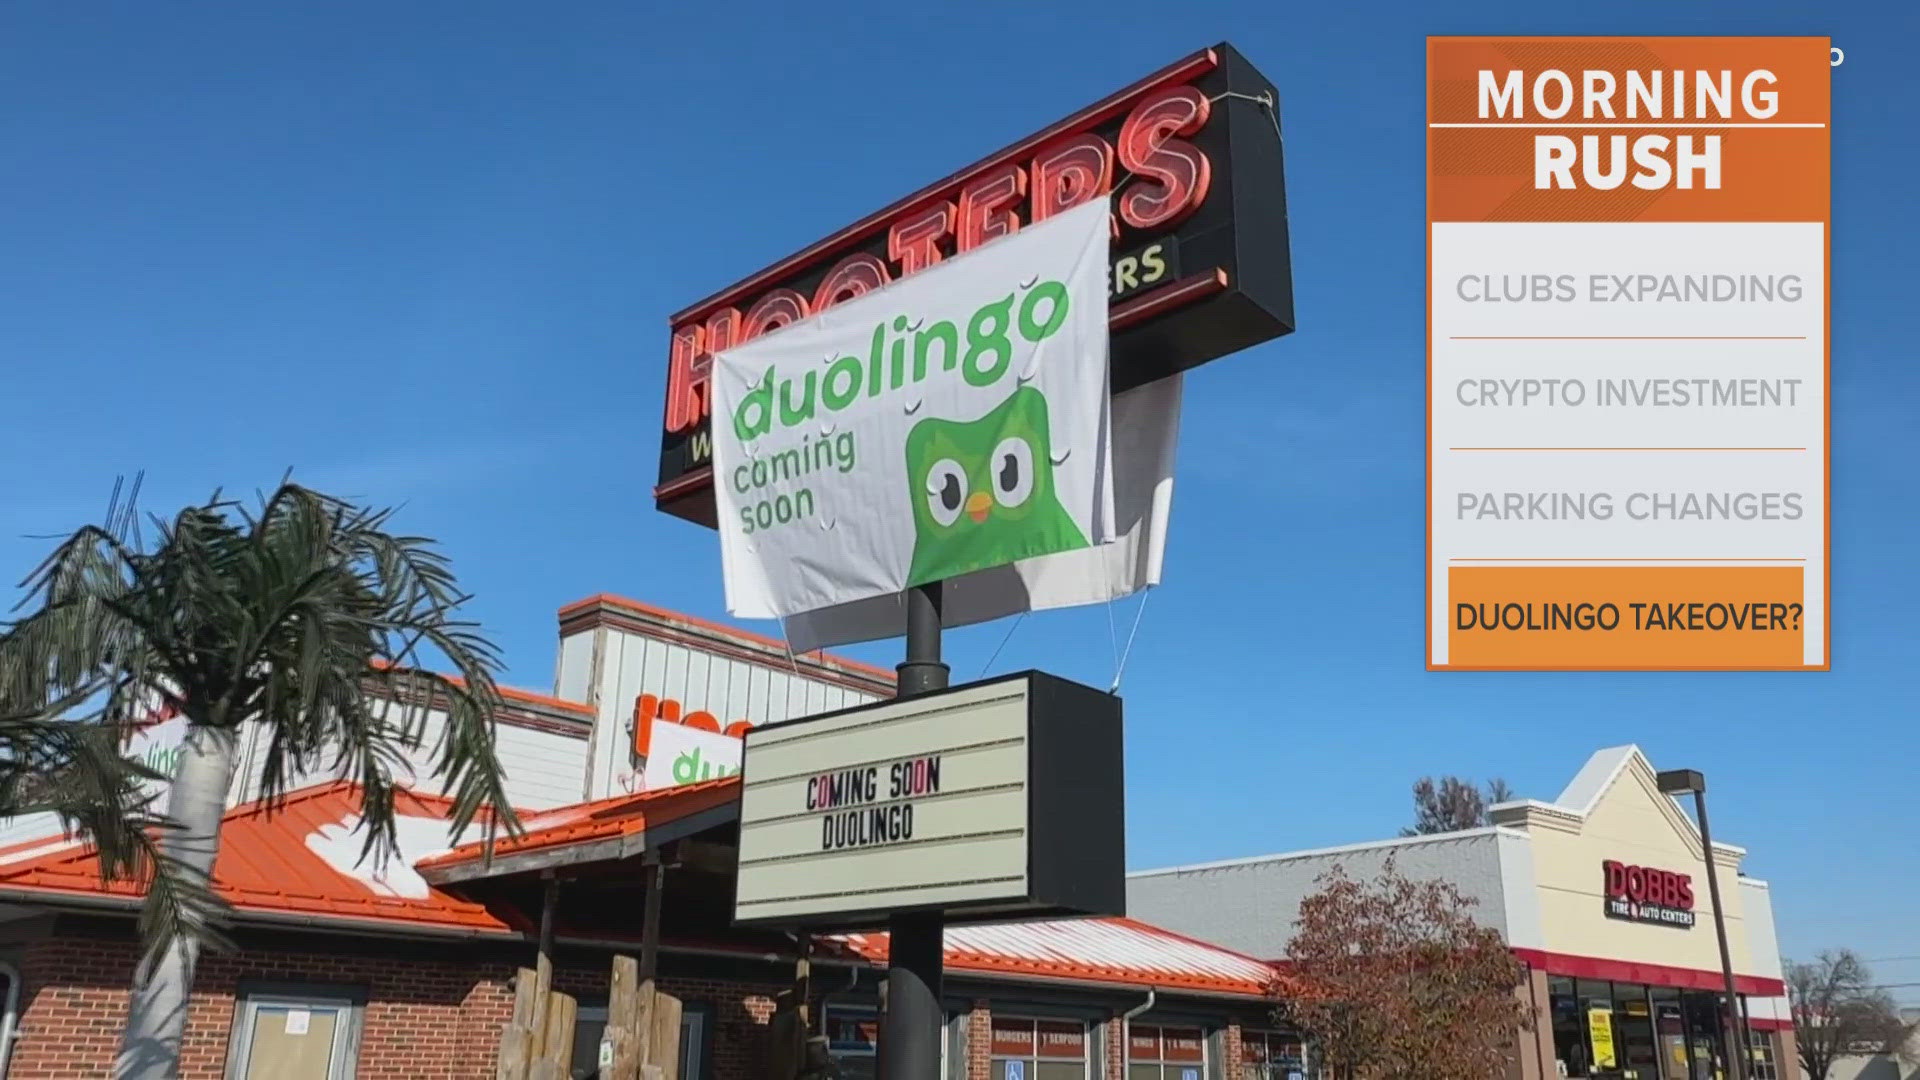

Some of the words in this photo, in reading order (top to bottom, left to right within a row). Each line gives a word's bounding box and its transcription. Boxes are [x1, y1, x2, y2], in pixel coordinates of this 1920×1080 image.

[734, 281, 1070, 440] duolingo
[734, 431, 855, 493] coming
[740, 488, 814, 534] soon
[807, 767, 877, 810] COMING
[890, 755, 941, 798] SOON
[823, 803, 914, 850] DUOLINGO
[1604, 860, 1694, 910] DOBBS
[1611, 901, 1629, 914] TIRE
[1639, 906, 1660, 919] AUTO
[1661, 909, 1693, 924] CENTERS
